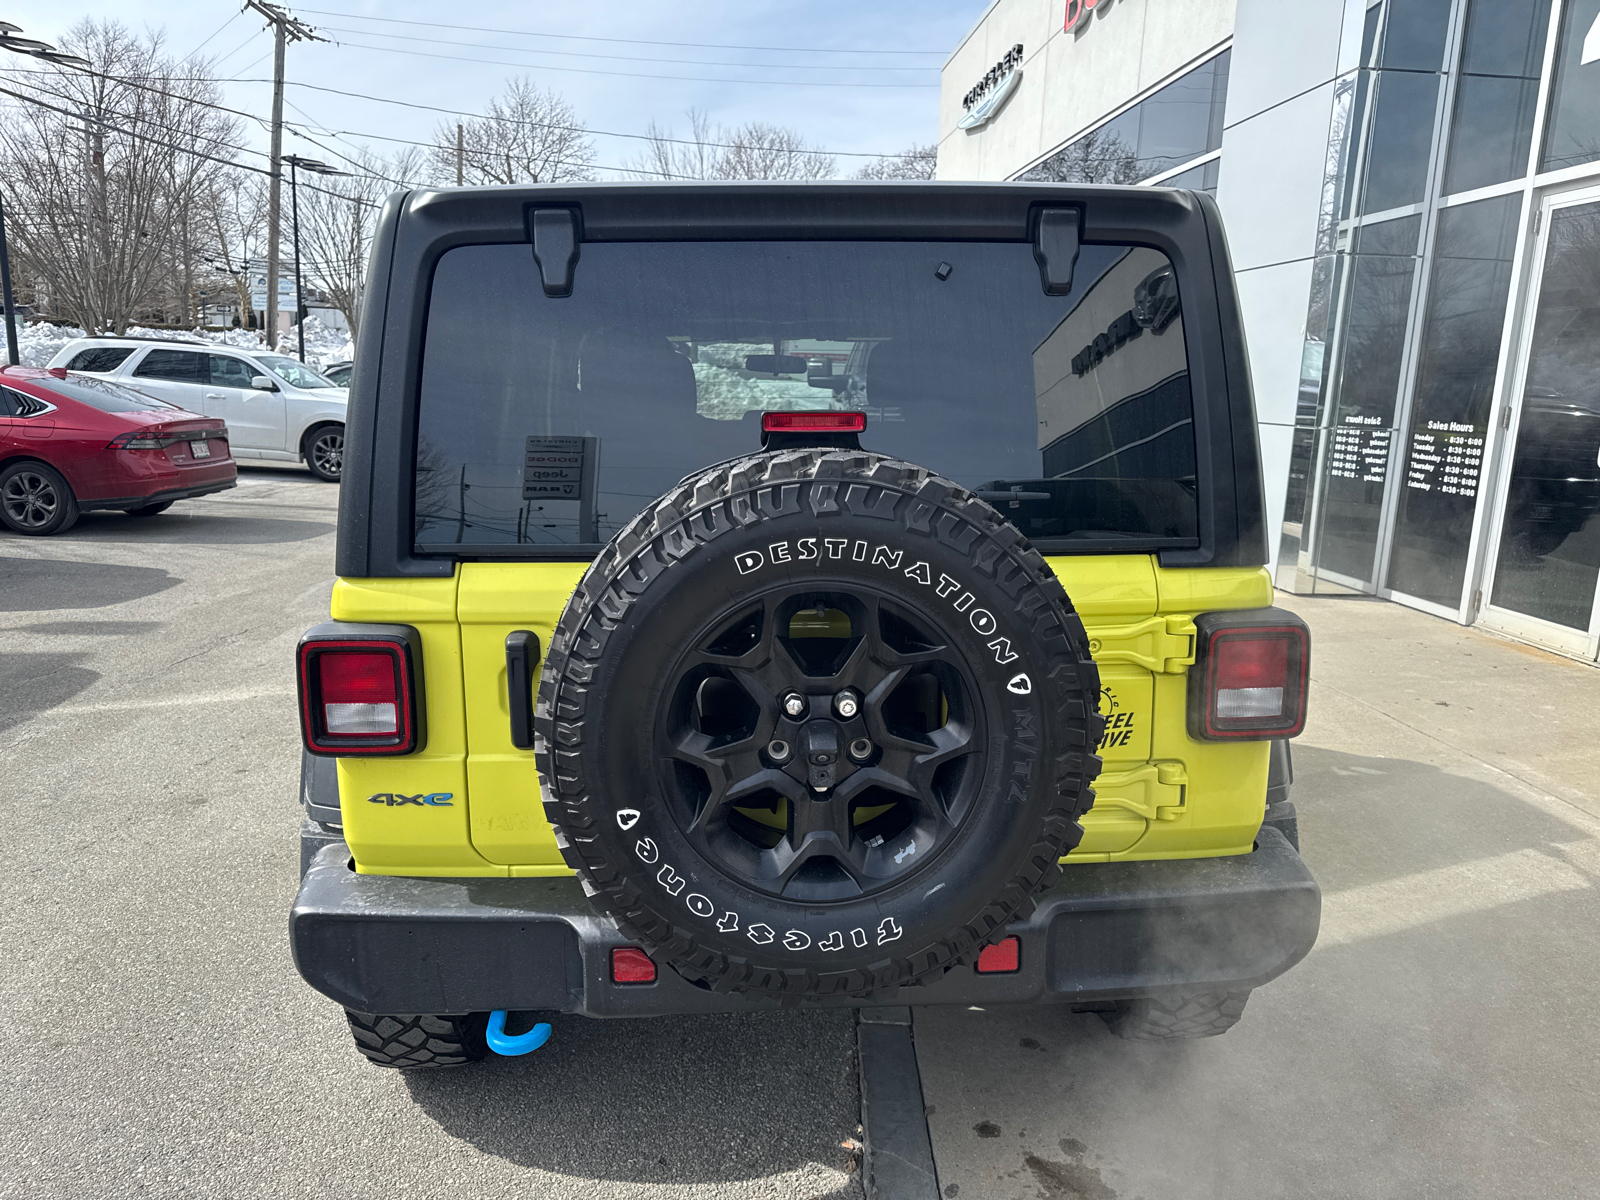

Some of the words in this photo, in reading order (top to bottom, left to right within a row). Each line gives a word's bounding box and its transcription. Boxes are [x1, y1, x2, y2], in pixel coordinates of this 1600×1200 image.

[1427, 420, 1449, 431] Sales
[1449, 421, 1474, 433] Hours
[1414, 433, 1435, 443] Monday
[1413, 443, 1435, 453] Tuesday
[1411, 452, 1441, 463] Wednesday
[1410, 461, 1435, 472] Thursday
[1408, 471, 1425, 480] Friday
[1407, 480, 1431, 491] Saturday
[734, 538, 1019, 664] DESTINATION
[1103, 712, 1134, 730] EEL
[1100, 730, 1133, 750] IVE
[635, 837, 903, 951] Firestone
